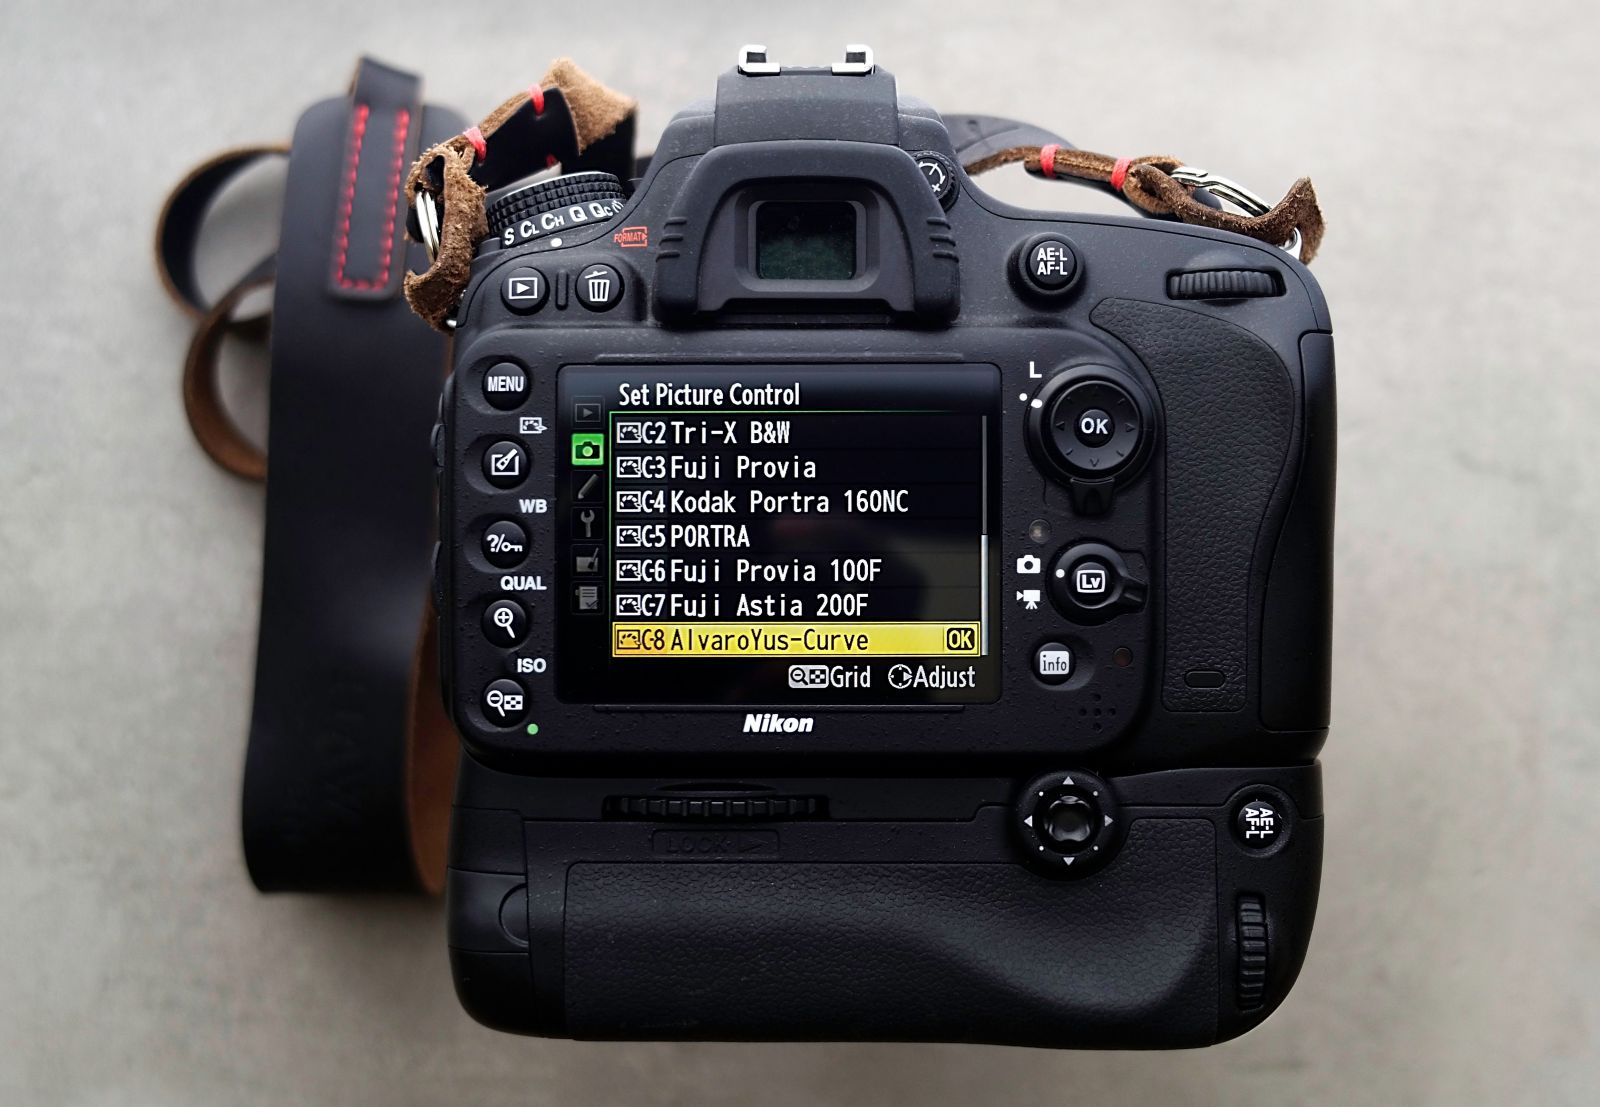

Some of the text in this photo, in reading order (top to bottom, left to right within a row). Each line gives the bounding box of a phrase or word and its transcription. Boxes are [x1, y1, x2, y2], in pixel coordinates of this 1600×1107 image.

[569, 206, 588, 222] Q
[504, 228, 515, 245] S
[613, 231, 643, 243] FORMAT
[1037, 247, 1068, 261] AE-L
[1037, 261, 1068, 276] AF-L
[1029, 361, 1043, 379] L
[487, 376, 524, 392] MENU
[618, 382, 800, 406] Set Picture Control
[670, 421, 737, 445] Tri-X
[750, 421, 790, 445] B&W
[1080, 418, 1109, 435] OK
[670, 455, 720, 480] Fuji
[736, 455, 817, 479] Provia
[519, 499, 547, 514] WB
[670, 490, 737, 513] Kodak
[750, 490, 830, 513] Portra
[843, 489, 909, 513] 160NC
[670, 525, 750, 548] PORTRA
[670, 559, 720, 583] Fuji
[736, 559, 816, 582] Provia
[830, 558, 882, 582] 100F
[500, 576, 547, 591] QUAL
[670, 594, 720, 617] Fuji
[736, 594, 803, 617] Astia
[816, 593, 869, 616] 200F
[670, 628, 869, 651] AlvaroYus-Curve
[948, 630, 974, 649] OK
[516, 657, 547, 673] ISO
[1042, 654, 1067, 672] info
[830, 665, 871, 688] Grid
[913, 665, 976, 689] Adjust
[742, 713, 814, 734] Nikon
[1245, 807, 1260, 839] AF-L
[1259, 807, 1274, 839] AE-L
